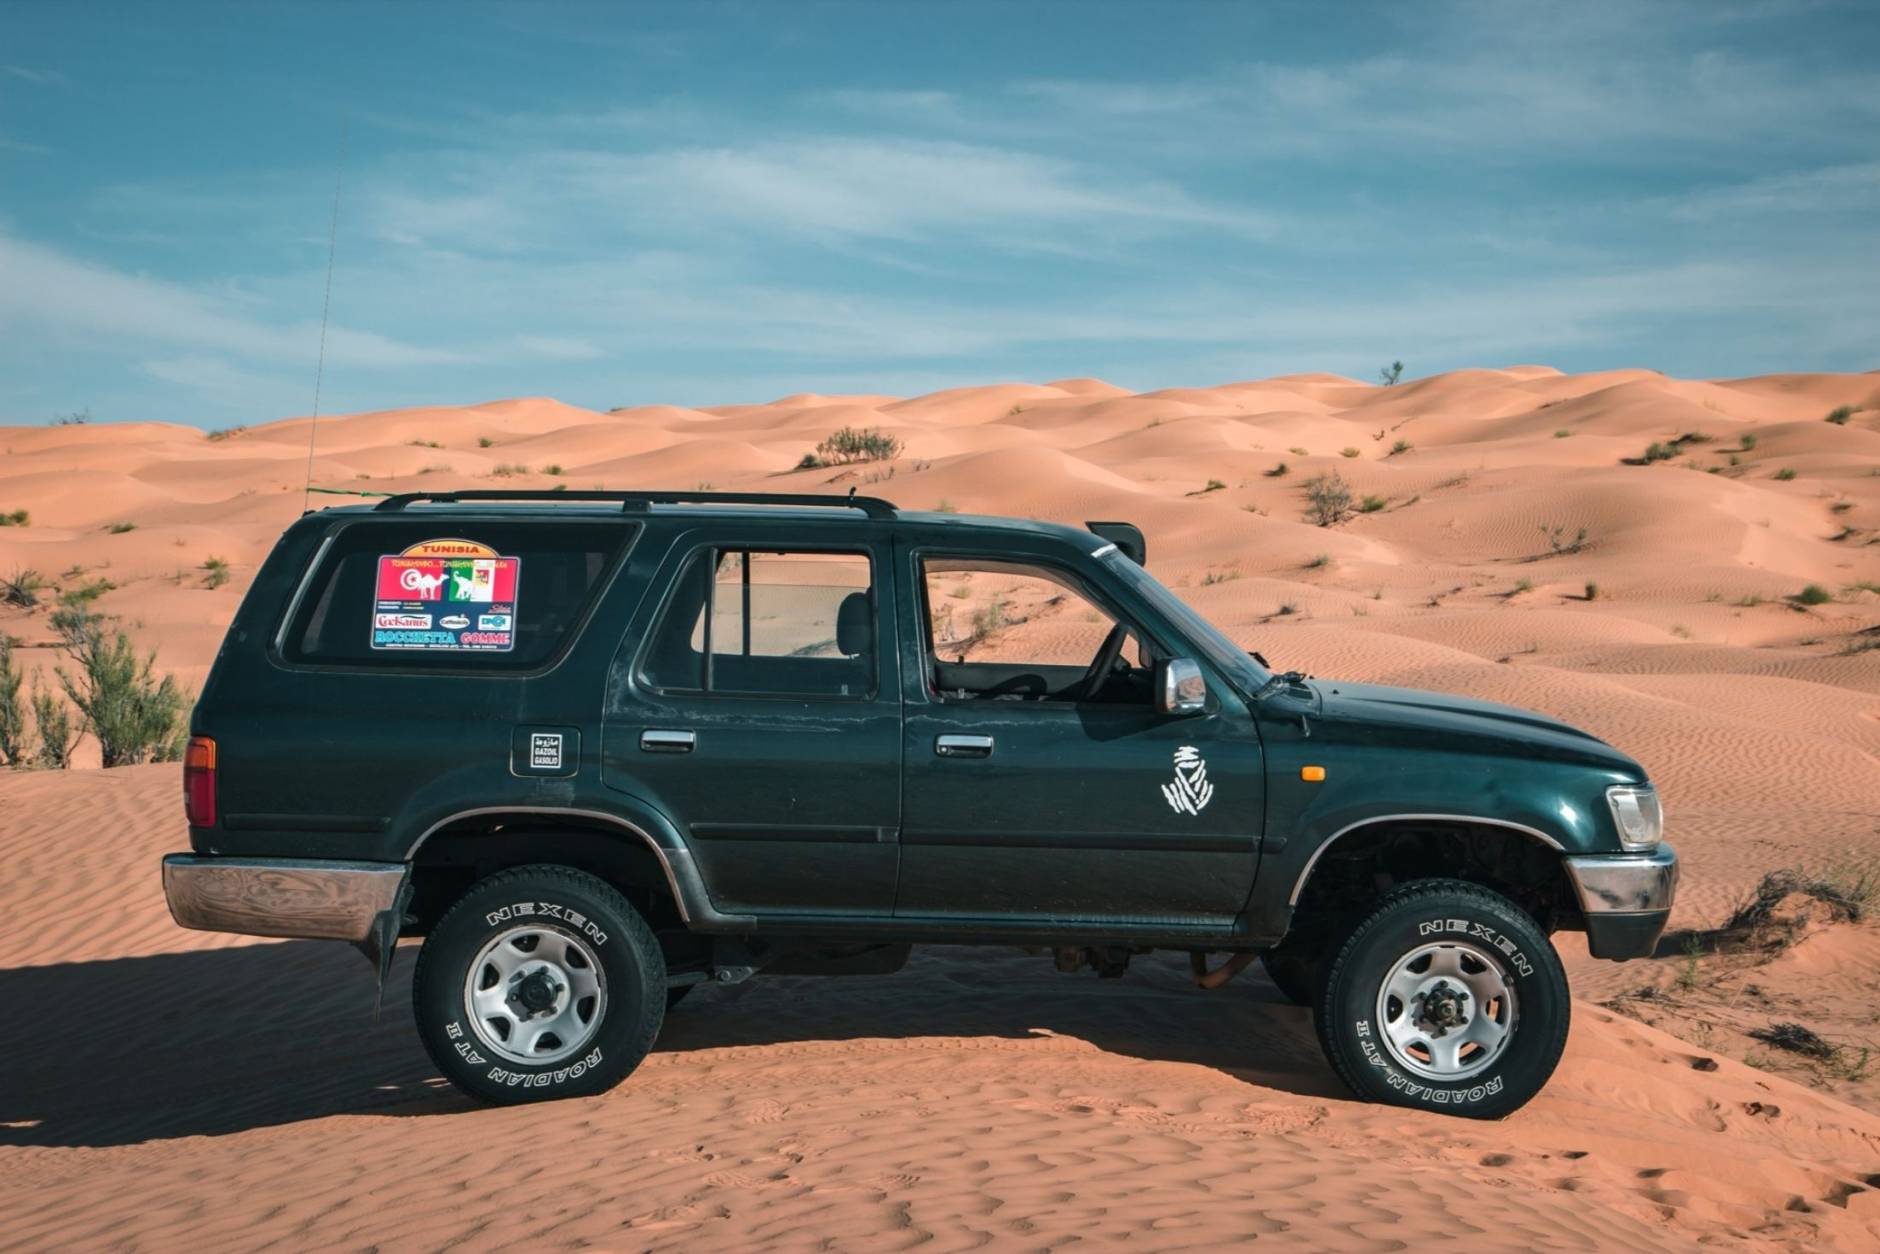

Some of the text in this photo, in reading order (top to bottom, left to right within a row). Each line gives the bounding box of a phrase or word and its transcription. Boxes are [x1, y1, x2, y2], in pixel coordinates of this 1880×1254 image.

[421, 545, 480, 554] TUNISIA
[375, 631, 511, 645] ROCCHETTA GOMME
[535, 747, 558, 756] GAZOIL
[535, 756, 558, 764] GASOLIO
[486, 902, 608, 945] NEXEN
[1419, 919, 1534, 977] NEXEN
[454, 1041, 487, 1065] AT
[1361, 1040, 1387, 1067] AT
[488, 1047, 603, 1087] ROADIAN
[1387, 1075, 1504, 1103] ROADIAN
